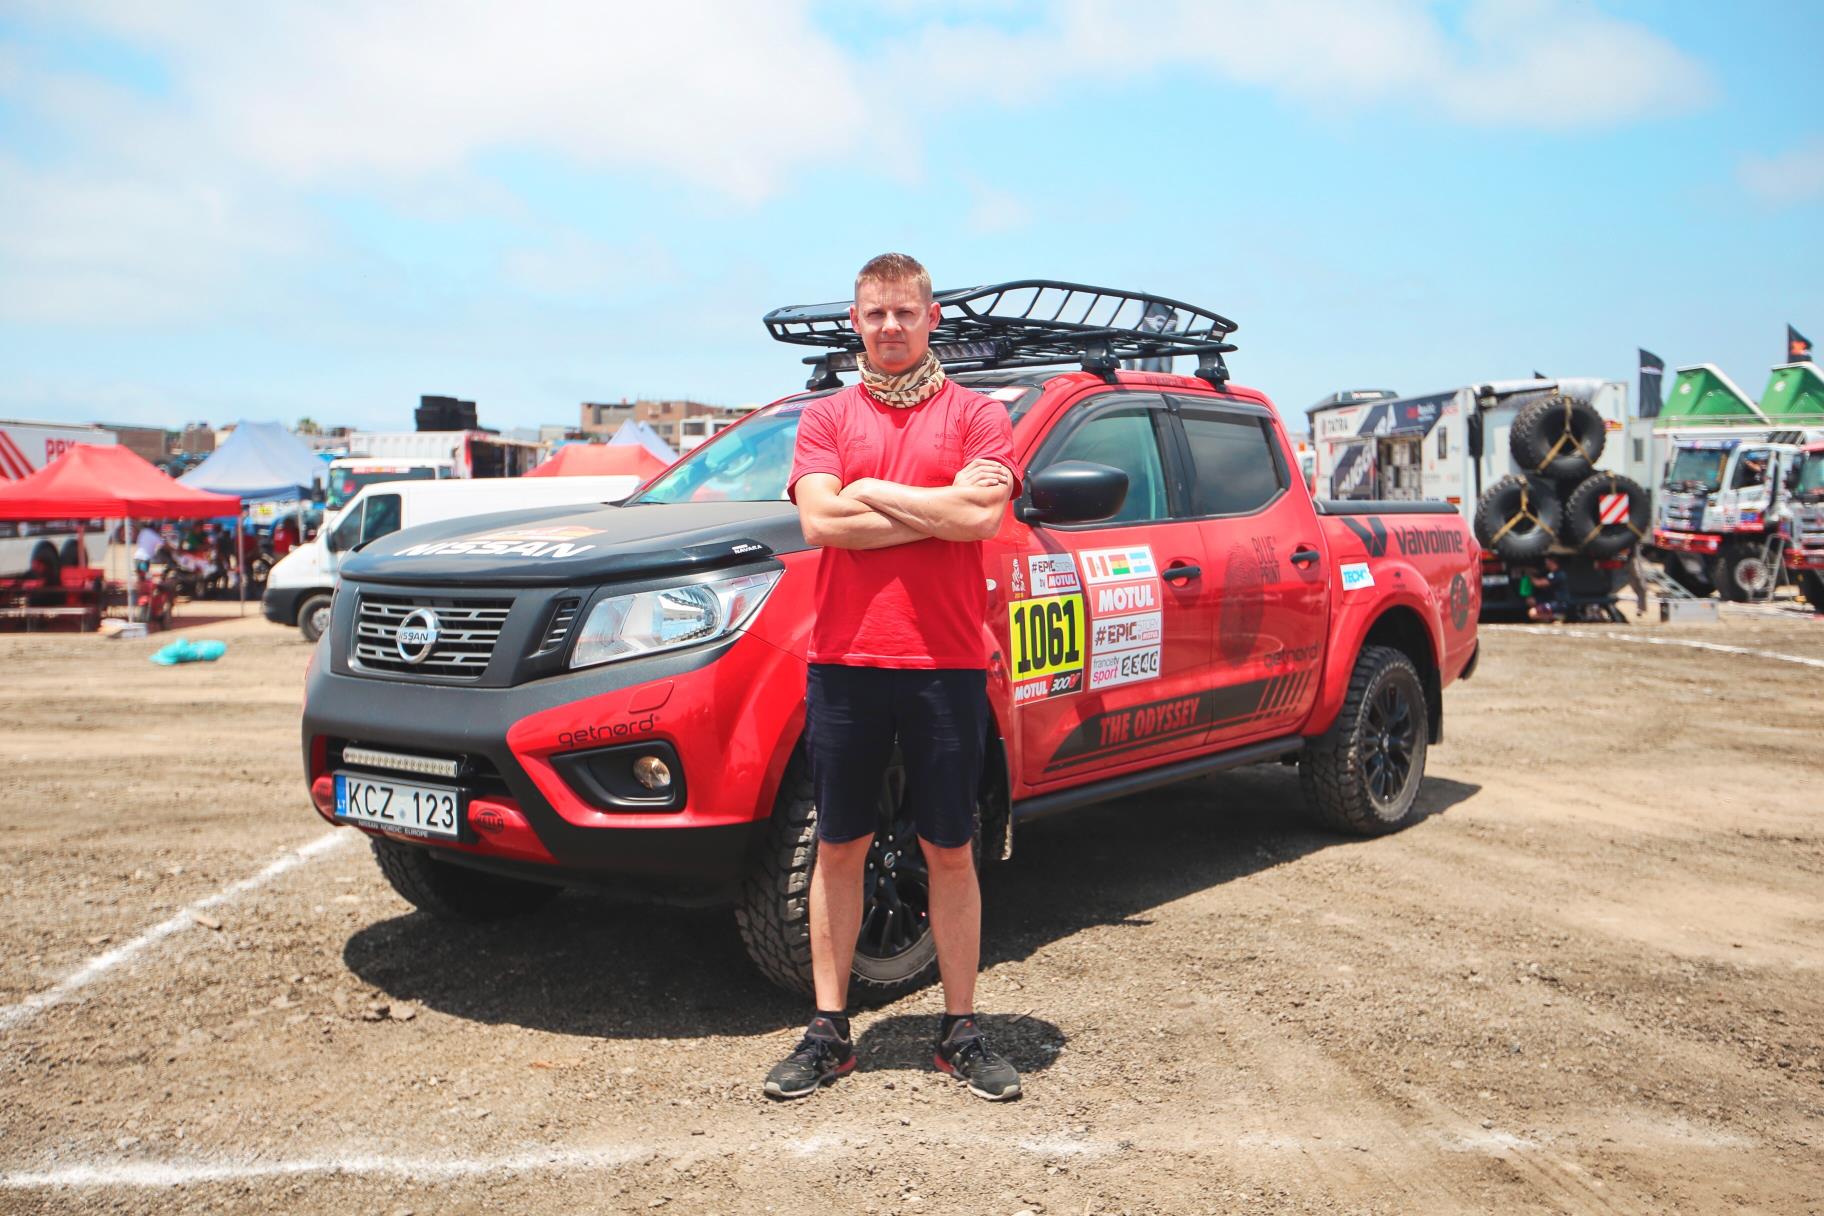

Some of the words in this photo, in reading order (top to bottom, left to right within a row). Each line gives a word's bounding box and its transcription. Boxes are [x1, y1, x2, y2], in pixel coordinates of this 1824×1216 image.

[393, 540, 595, 558] NISSAN
[1391, 525, 1464, 556] Valvoline
[1048, 573, 1076, 587] MOTUL
[1098, 585, 1154, 613] MOTUL
[1014, 600, 1080, 674] 1061
[1015, 681, 1048, 700] MOTUL
[1050, 673, 1081, 692] 300V
[1092, 666, 1119, 686] sport
[1100, 712, 1131, 746] THE
[1134, 697, 1200, 736] ODYSSEY
[337, 799, 346, 810] LT
[349, 782, 394, 820] KCZ
[413, 791, 454, 828] 123
